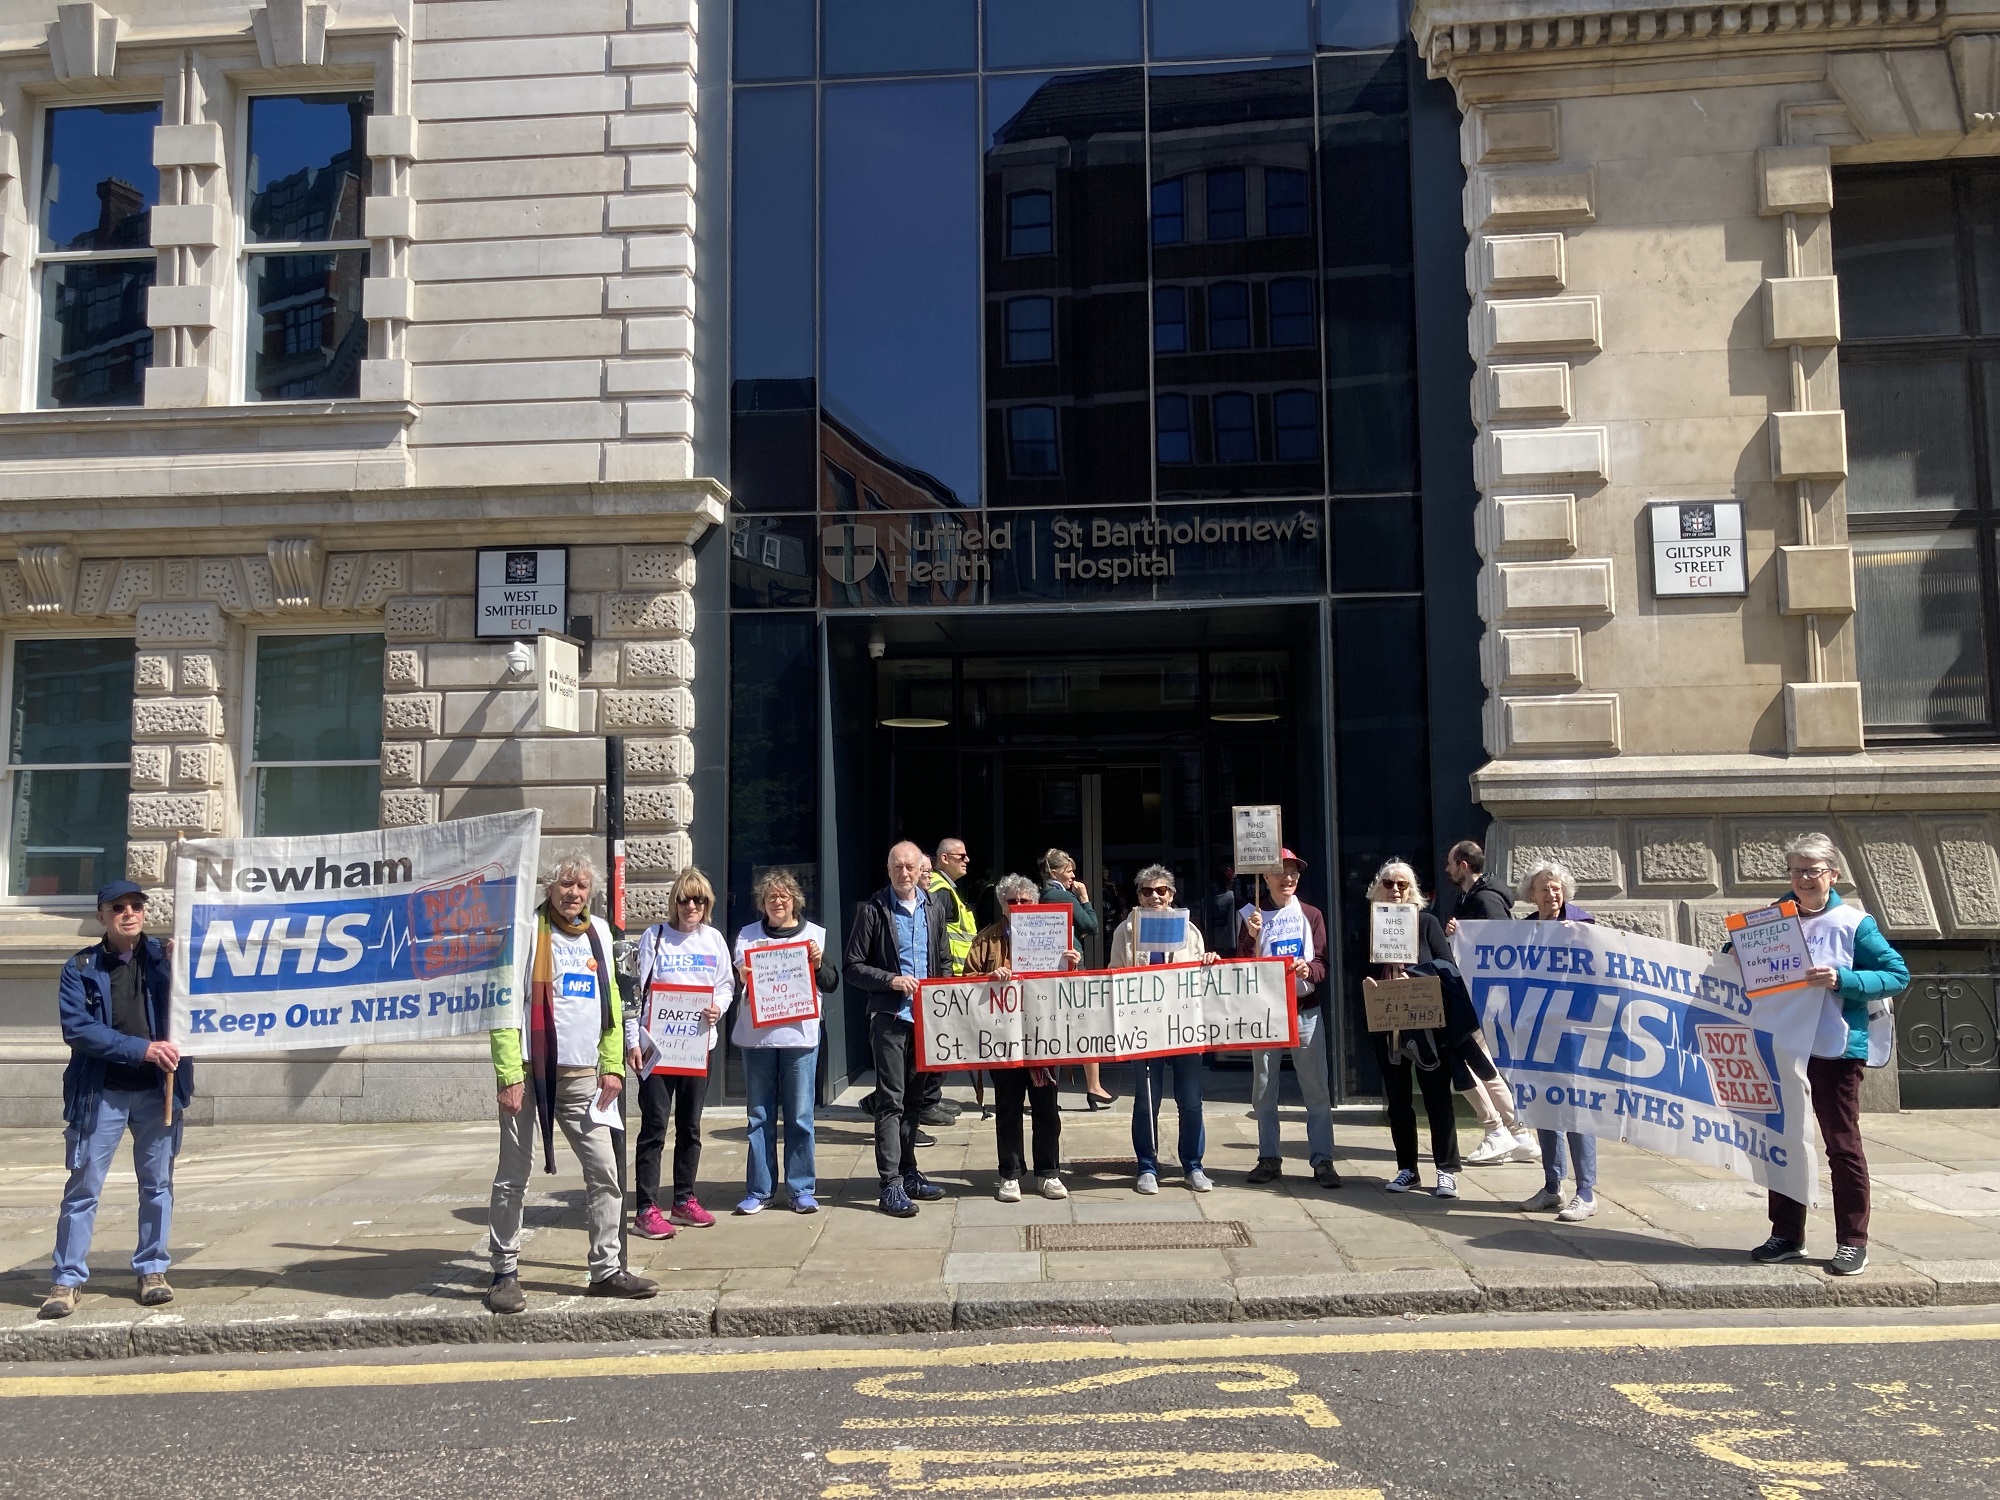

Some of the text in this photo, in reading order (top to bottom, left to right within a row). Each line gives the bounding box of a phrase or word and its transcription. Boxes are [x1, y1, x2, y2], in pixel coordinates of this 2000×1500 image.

[888, 510, 1317, 553] Nuffield St Bartholomew's
[1666, 546, 1732, 558] GILTSPUR
[889, 550, 1176, 584] Health Hospital
[1674, 561, 1724, 573] STREET
[504, 591, 538, 602] WEST
[485, 604, 558, 616] SMITHFIELD
[559, 673, 577, 688] Nuffield
[559, 687, 575, 698] Health
[195, 856, 413, 893] Newham
[422, 874, 487, 919] NOT
[431, 902, 491, 941] FOR
[1263, 916, 1302, 930] NEWHAM
[1385, 918, 1402, 926] NHS
[1266, 926, 1302, 938] SAVE OUR
[1382, 928, 1405, 936] BEDS
[1740, 923, 1790, 942] NUFFIELD
[195, 913, 371, 978] NHS
[424, 925, 501, 972] SALE
[1030, 938, 1054, 946] NHS
[1742, 936, 1779, 950] HEALTH
[1762, 942, 1790, 954] Charity
[756, 950, 788, 960] NUFFIELD
[781, 951, 802, 960] HEALTH
[1276, 944, 1298, 956] NHS
[560, 958, 582, 967] SAVE
[661, 954, 694, 966] NHS
[1747, 956, 1801, 972] takes NHS
[758, 971, 778, 979] private
[1475, 944, 1753, 1016] TOWER HAMLETS
[569, 980, 592, 992] NHS
[772, 984, 788, 994] NO
[932, 966, 1259, 1018] SAY NO! to NUFFIELD HEALTH
[190, 982, 512, 1036] Keep Our NHS Public
[761, 1002, 786, 1012] health
[658, 1008, 702, 1022] BARTS
[764, 1009, 790, 1020] wanted
[994, 1011, 1086, 1026] private
[1118, 1006, 1163, 1018] beds
[1410, 1011, 1434, 1021] NHS
[665, 1024, 697, 1036] NHS
[936, 1008, 1279, 1062] St. Bartholomew's Hospital.
[1480, 985, 1671, 1078] NHS
[1704, 1032, 1748, 1056] NOT
[1712, 1058, 1762, 1080] FOR
[1717, 1082, 1772, 1106] SALE
[1546, 1081, 1607, 1110] our
[1615, 1090, 1685, 1130] NHS
[1692, 1115, 1788, 1168] public
